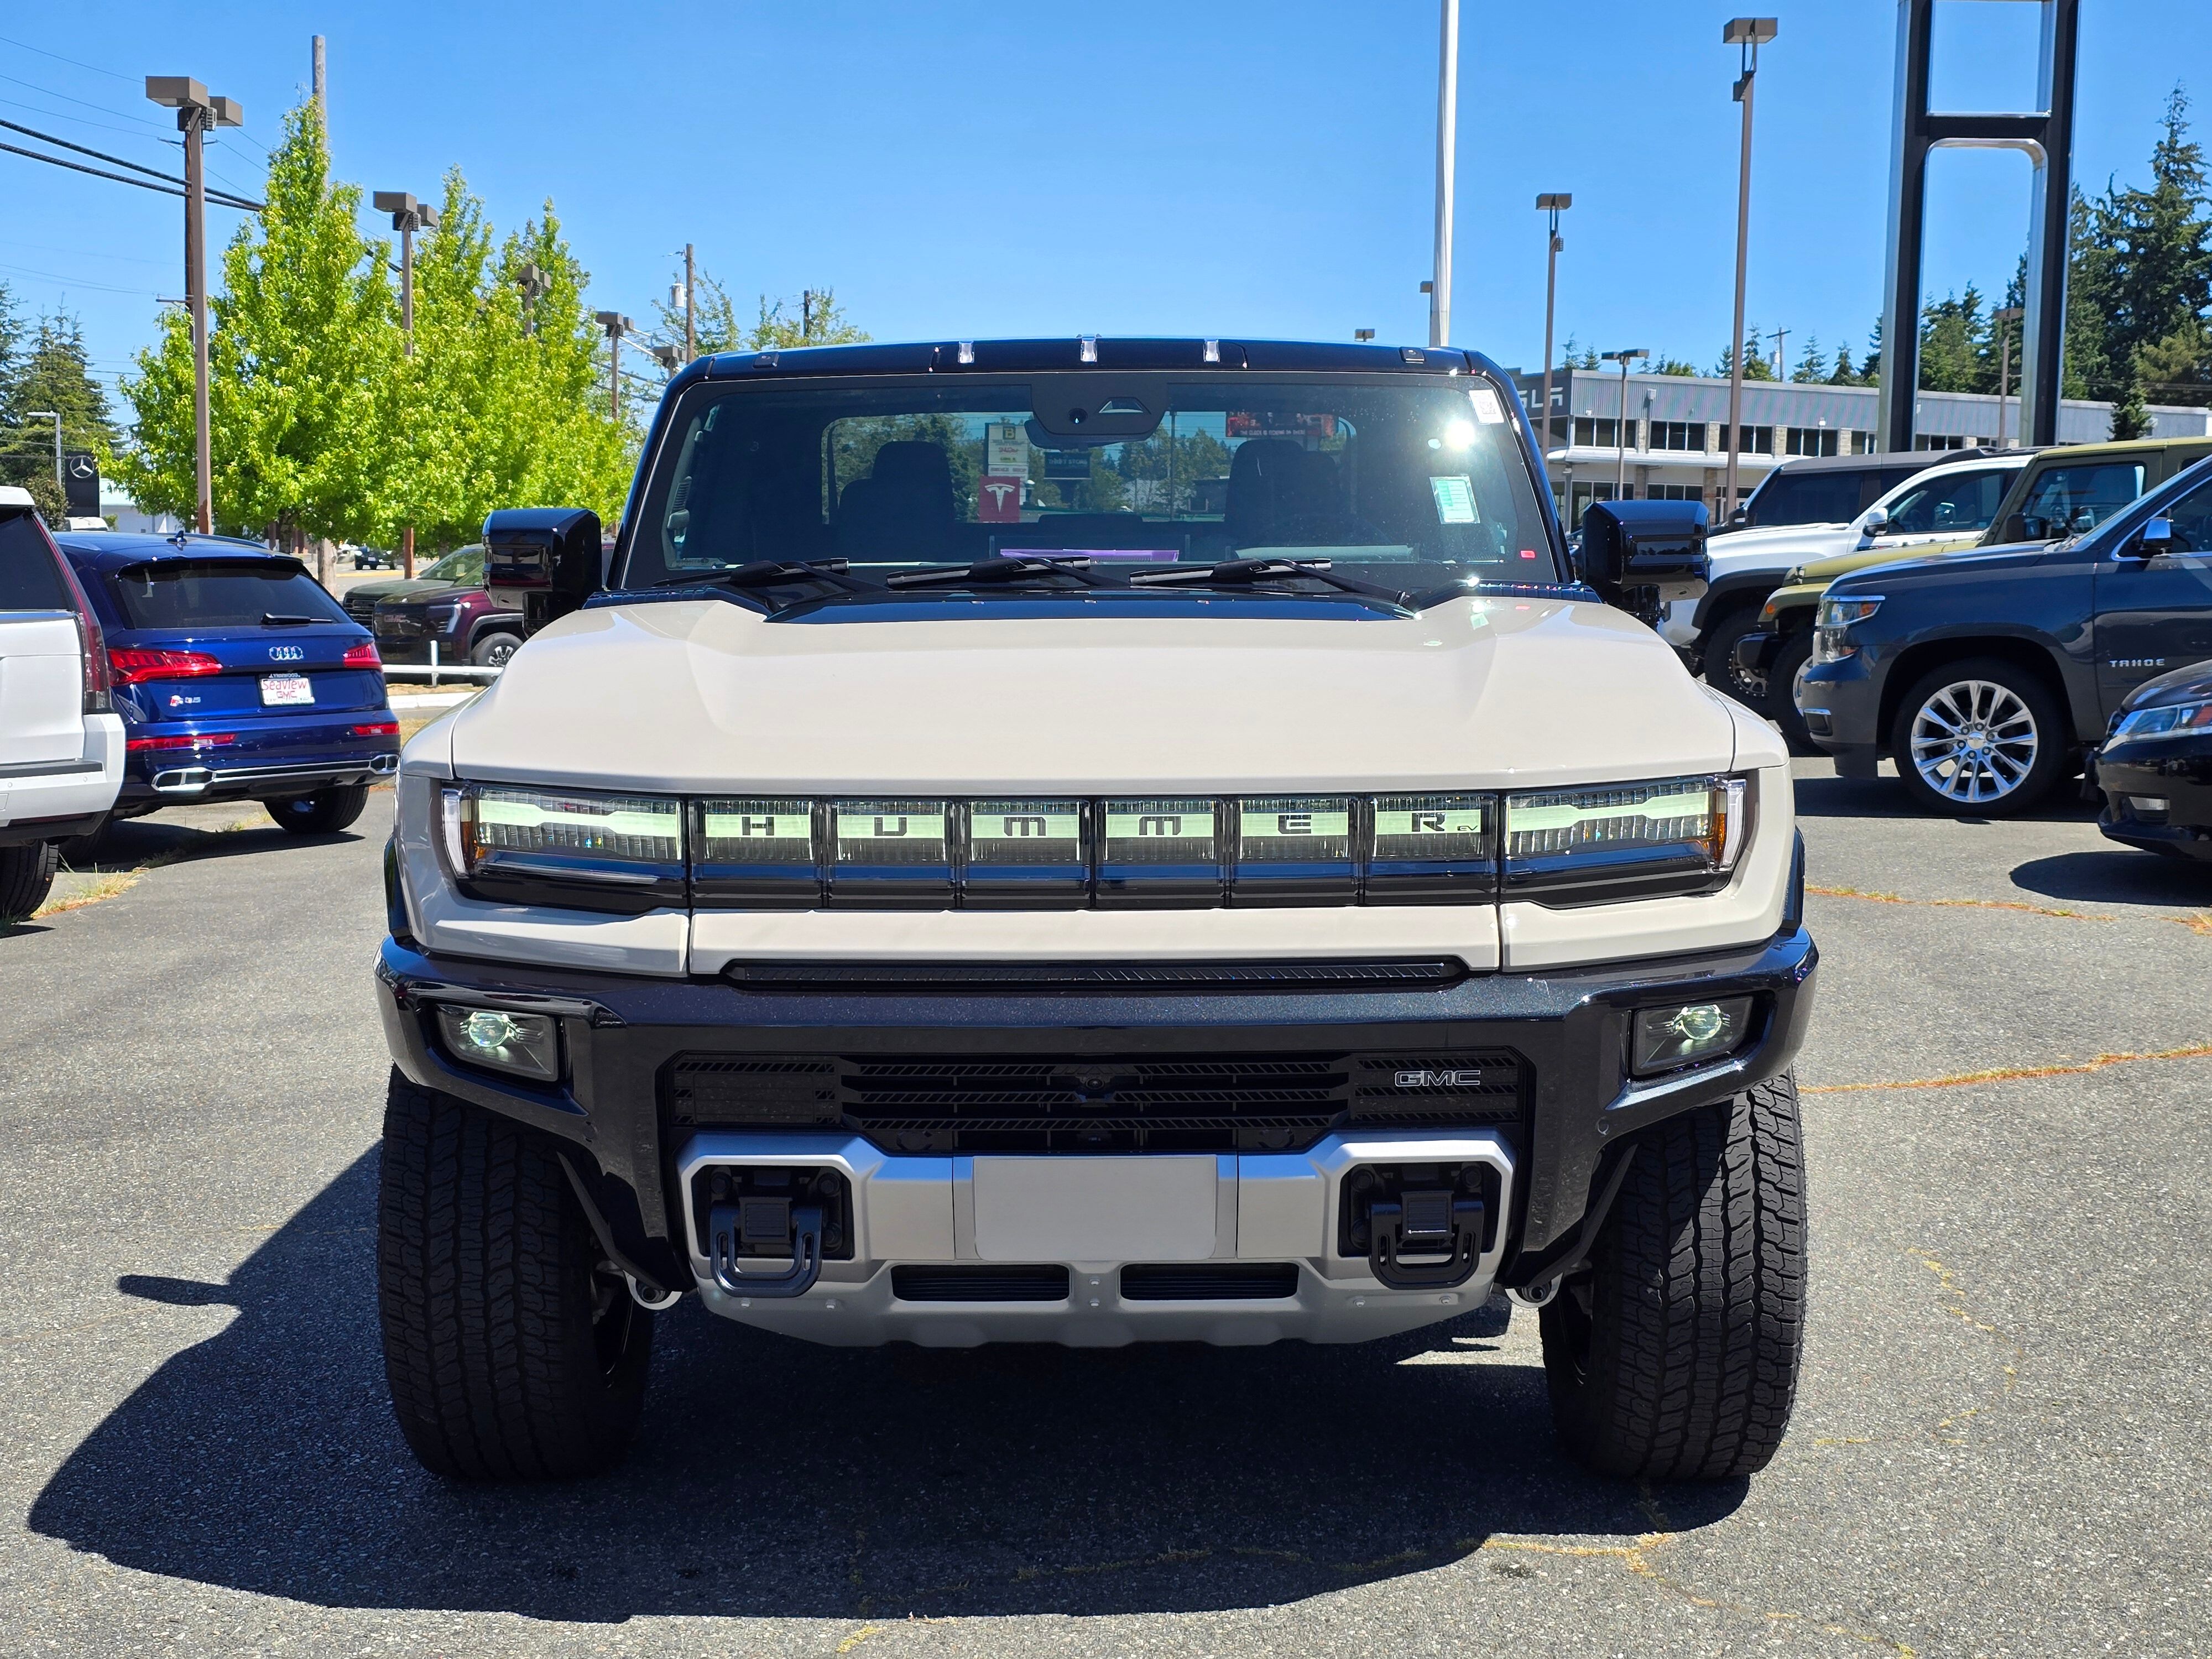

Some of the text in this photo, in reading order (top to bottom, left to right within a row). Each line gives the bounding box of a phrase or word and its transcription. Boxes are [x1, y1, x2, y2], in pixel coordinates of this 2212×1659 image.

[2109, 658, 2165, 667] TAHOE
[276, 691, 298, 699] GMC
[1395, 1070, 1481, 1087] GMC
